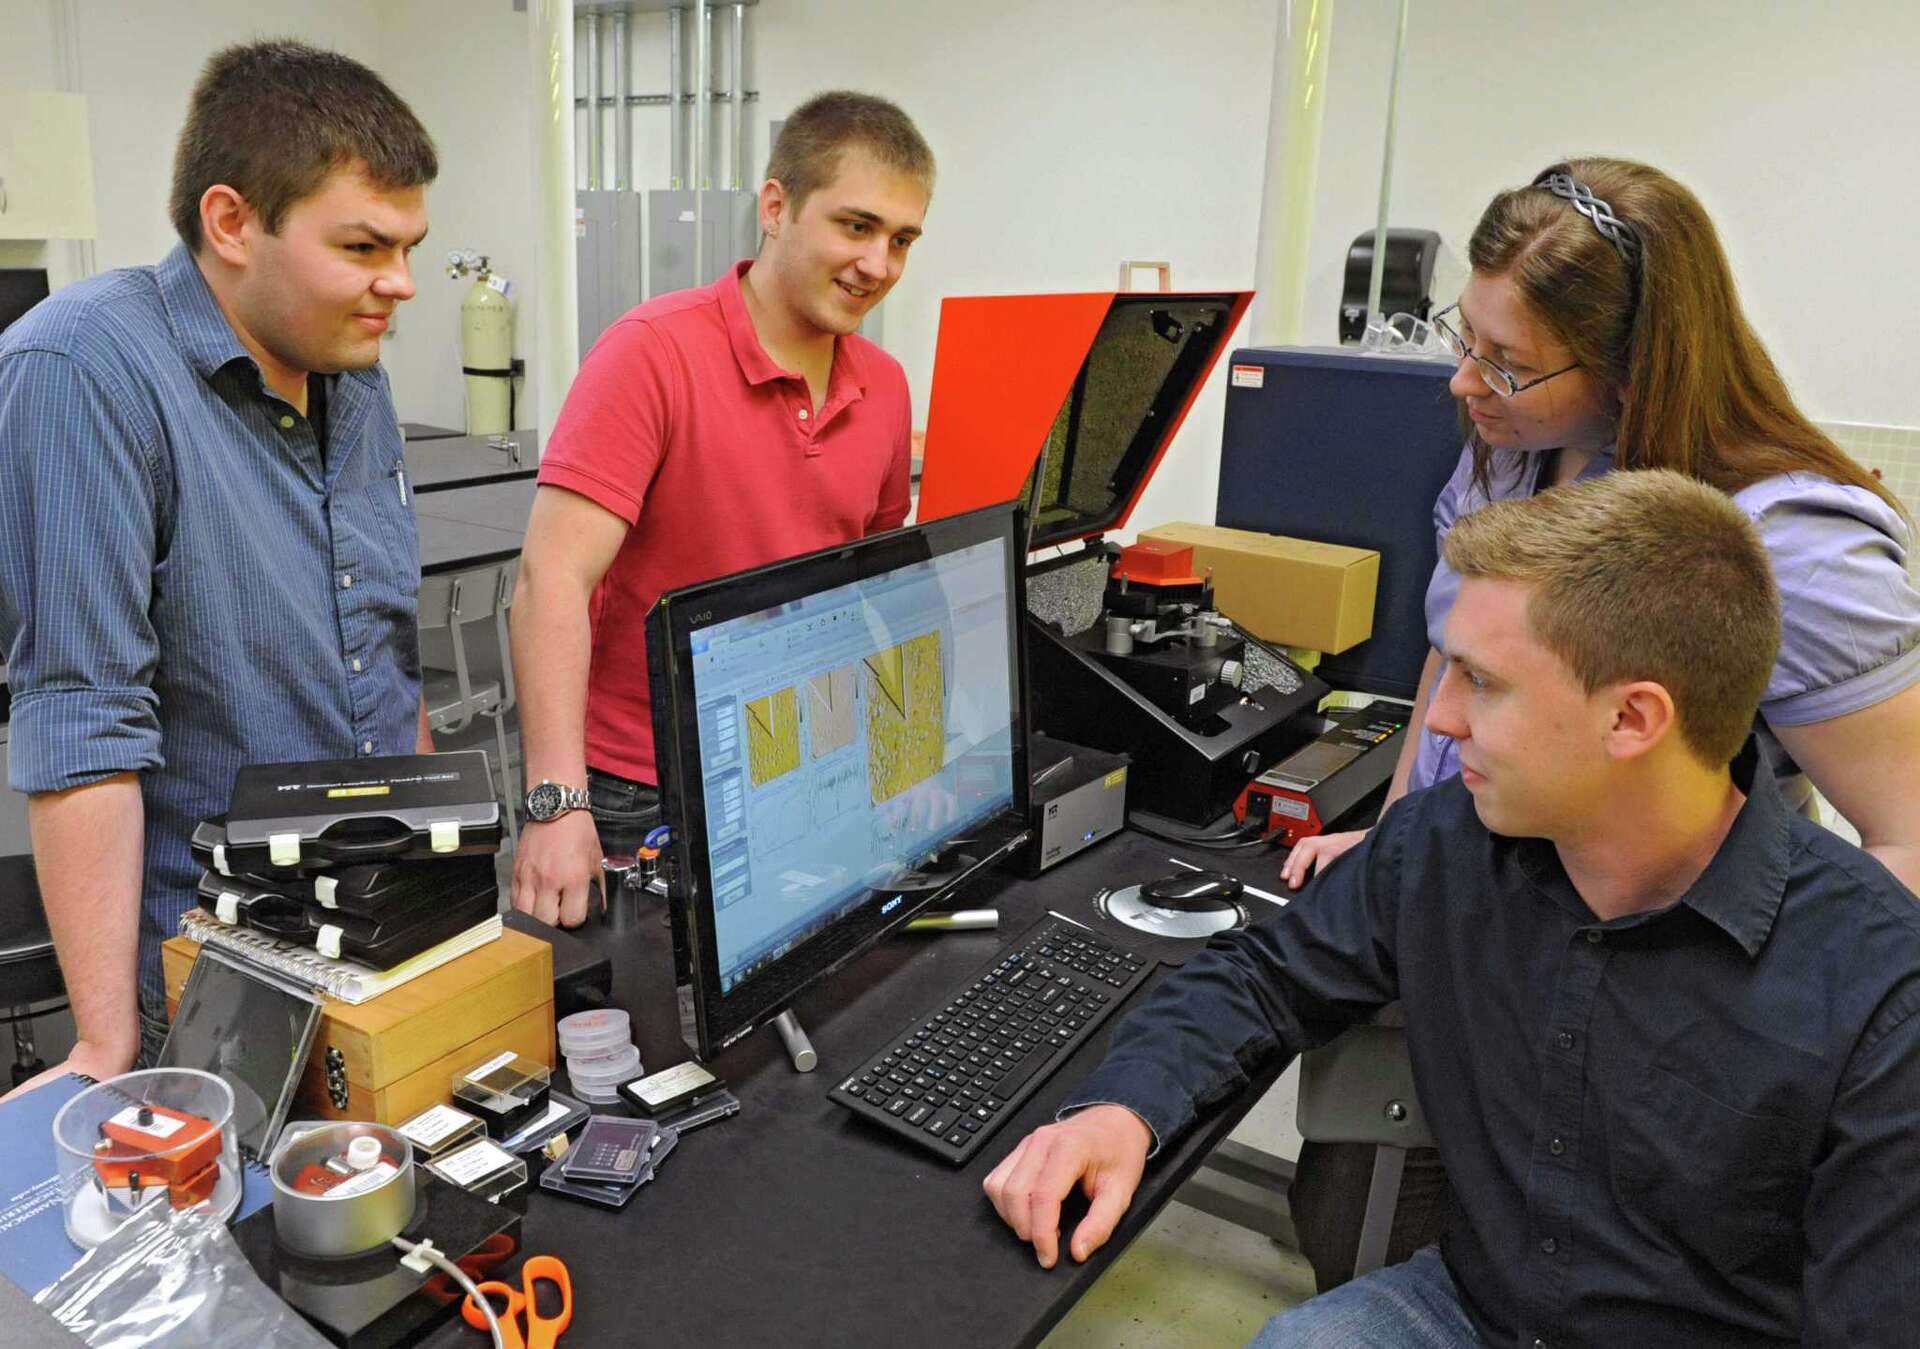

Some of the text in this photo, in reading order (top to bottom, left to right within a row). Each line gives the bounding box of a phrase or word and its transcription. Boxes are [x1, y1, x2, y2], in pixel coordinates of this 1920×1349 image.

[689, 610, 712, 624] VAIO
[881, 895, 903, 914] SONY
[0, 1196, 64, 1233] NANOSCAL
